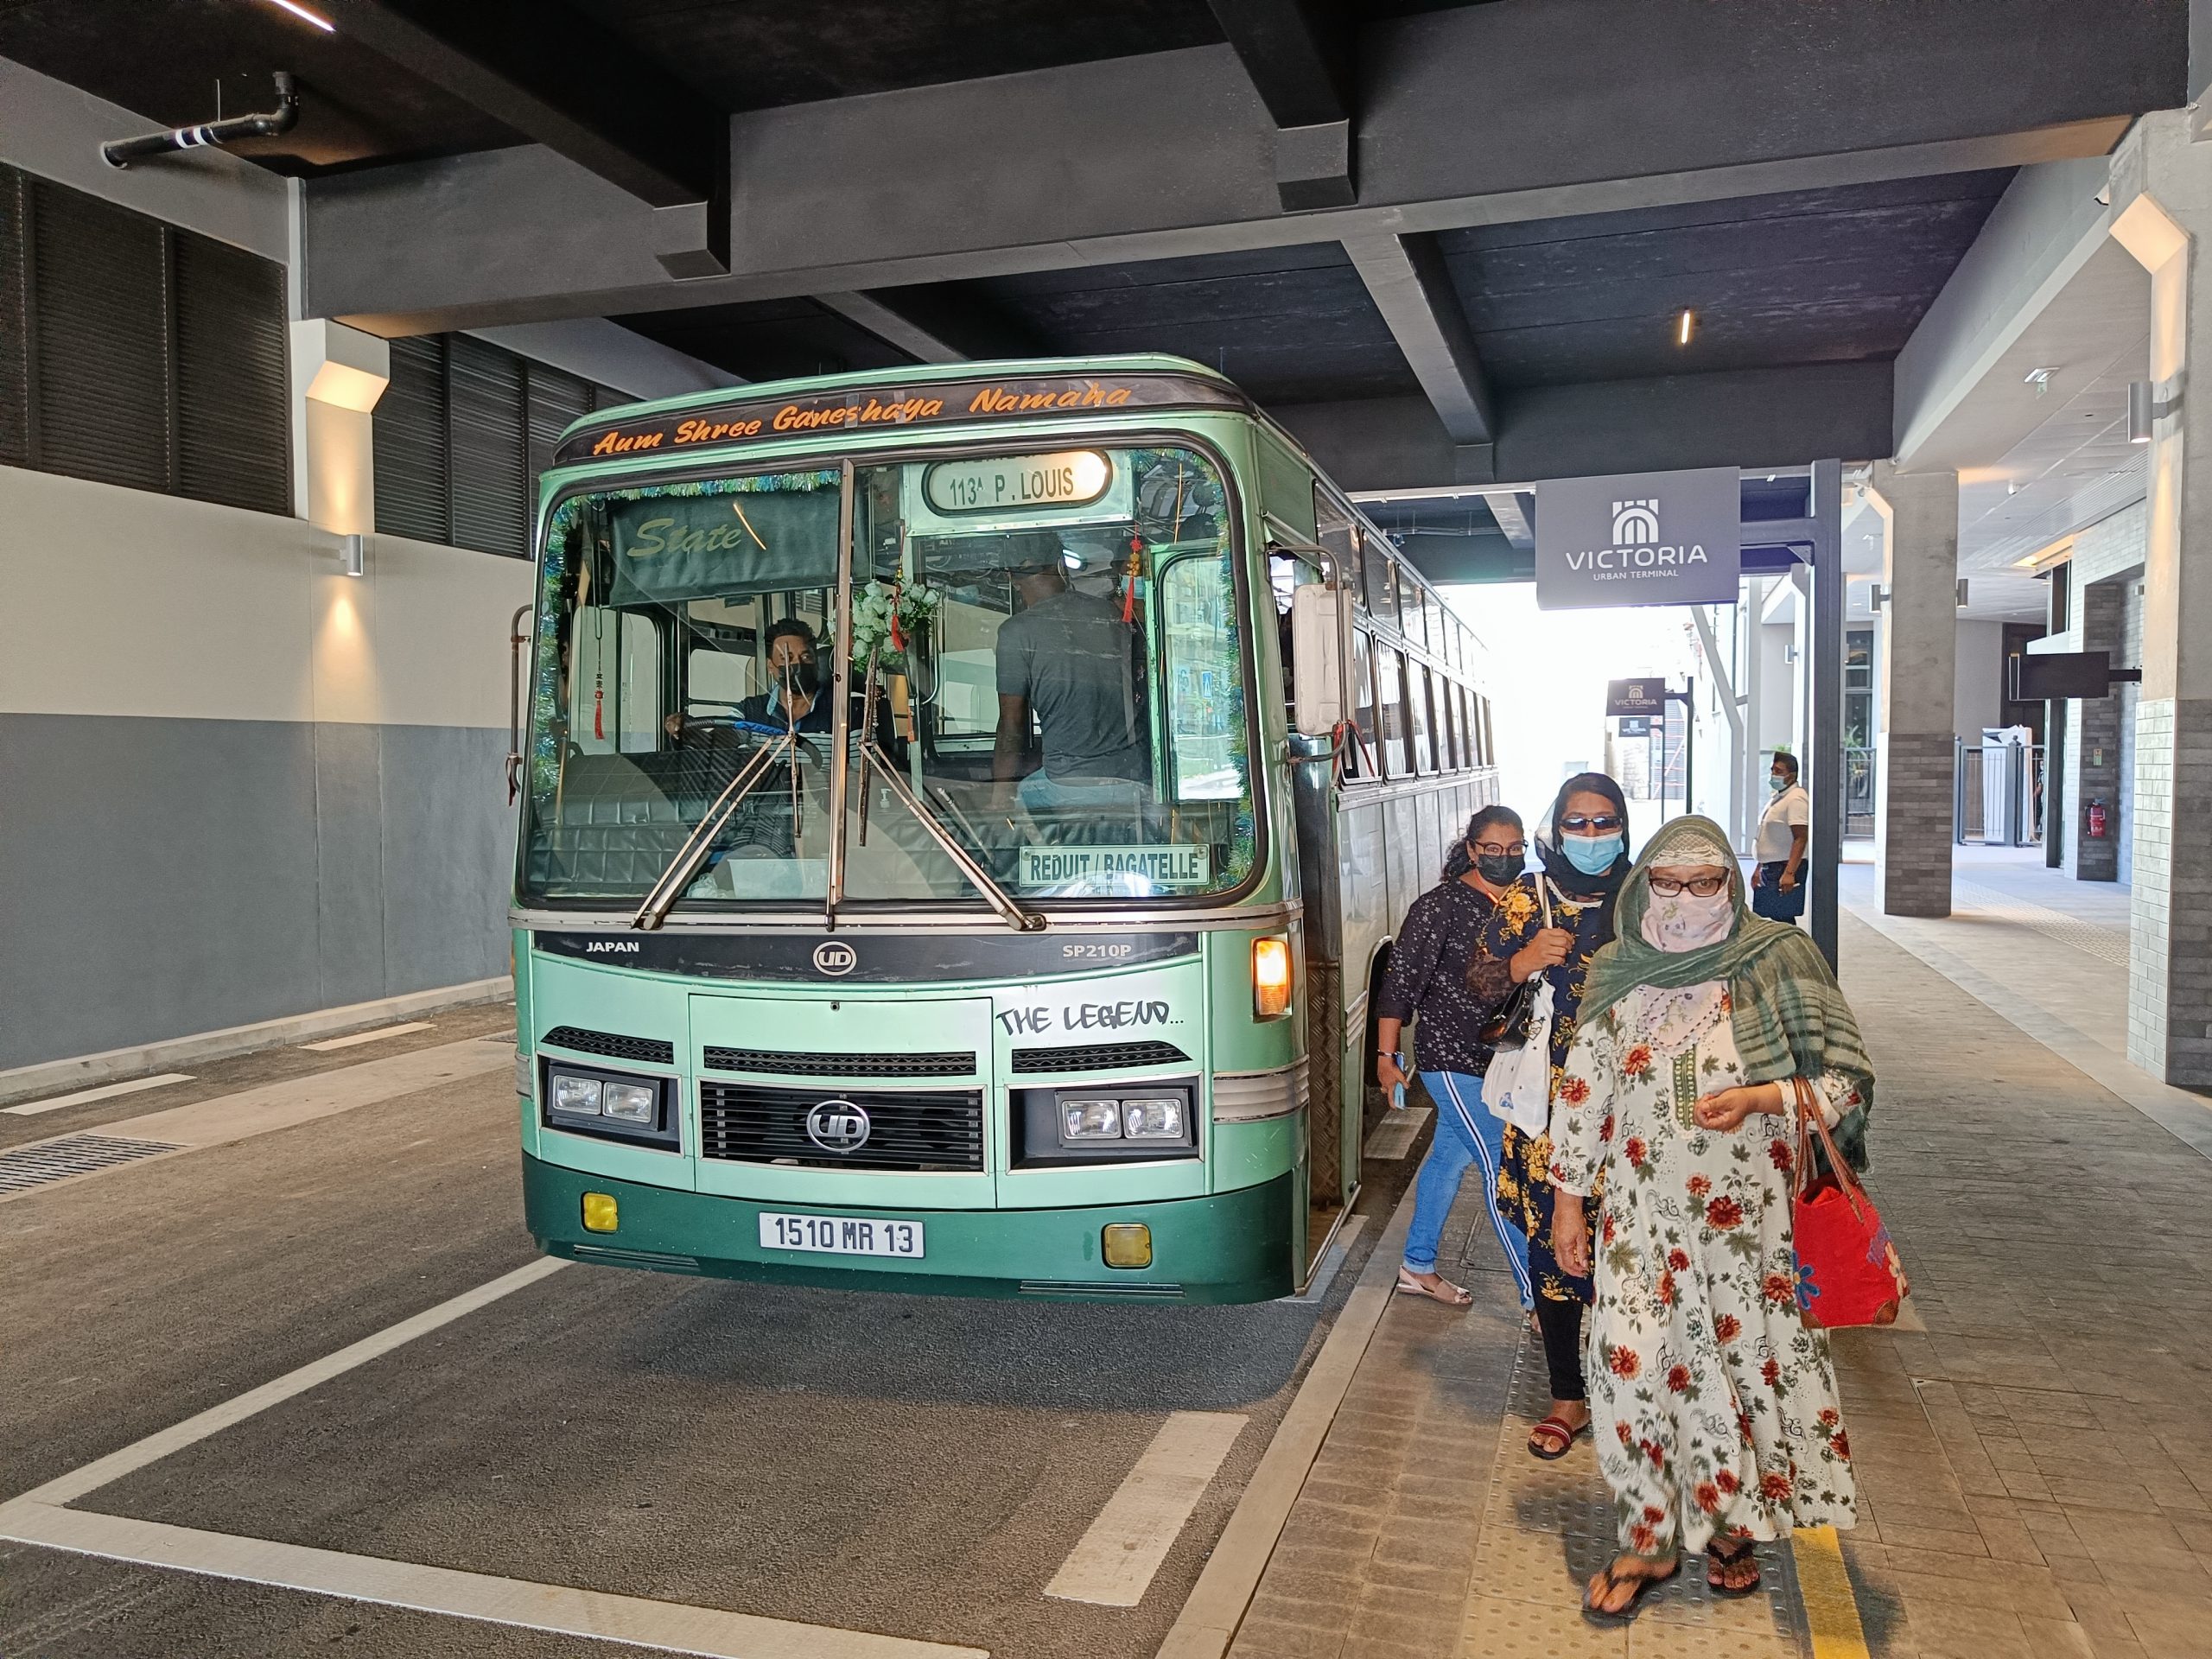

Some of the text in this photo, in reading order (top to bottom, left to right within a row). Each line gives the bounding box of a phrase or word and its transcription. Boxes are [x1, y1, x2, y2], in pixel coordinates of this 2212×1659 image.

[593, 382, 1132, 456] Aum Shree Ganeshaya Namaha
[1021, 467, 1074, 499] LOUIS
[626, 518, 742, 557] State
[1566, 544, 1707, 570] VICTORIA
[1593, 569, 1679, 581] URBAN TERMINAL
[1031, 854, 1090, 880] REDUIT
[1104, 852, 1198, 880] BAGATELLE
[586, 942, 639, 952] JAPAN
[818, 951, 852, 966] UD
[1063, 944, 1132, 957] SP210P
[995, 1006, 1052, 1036] THE
[810, 1114, 865, 1138] UD
[775, 1217, 913, 1253] 1510 MR 13
